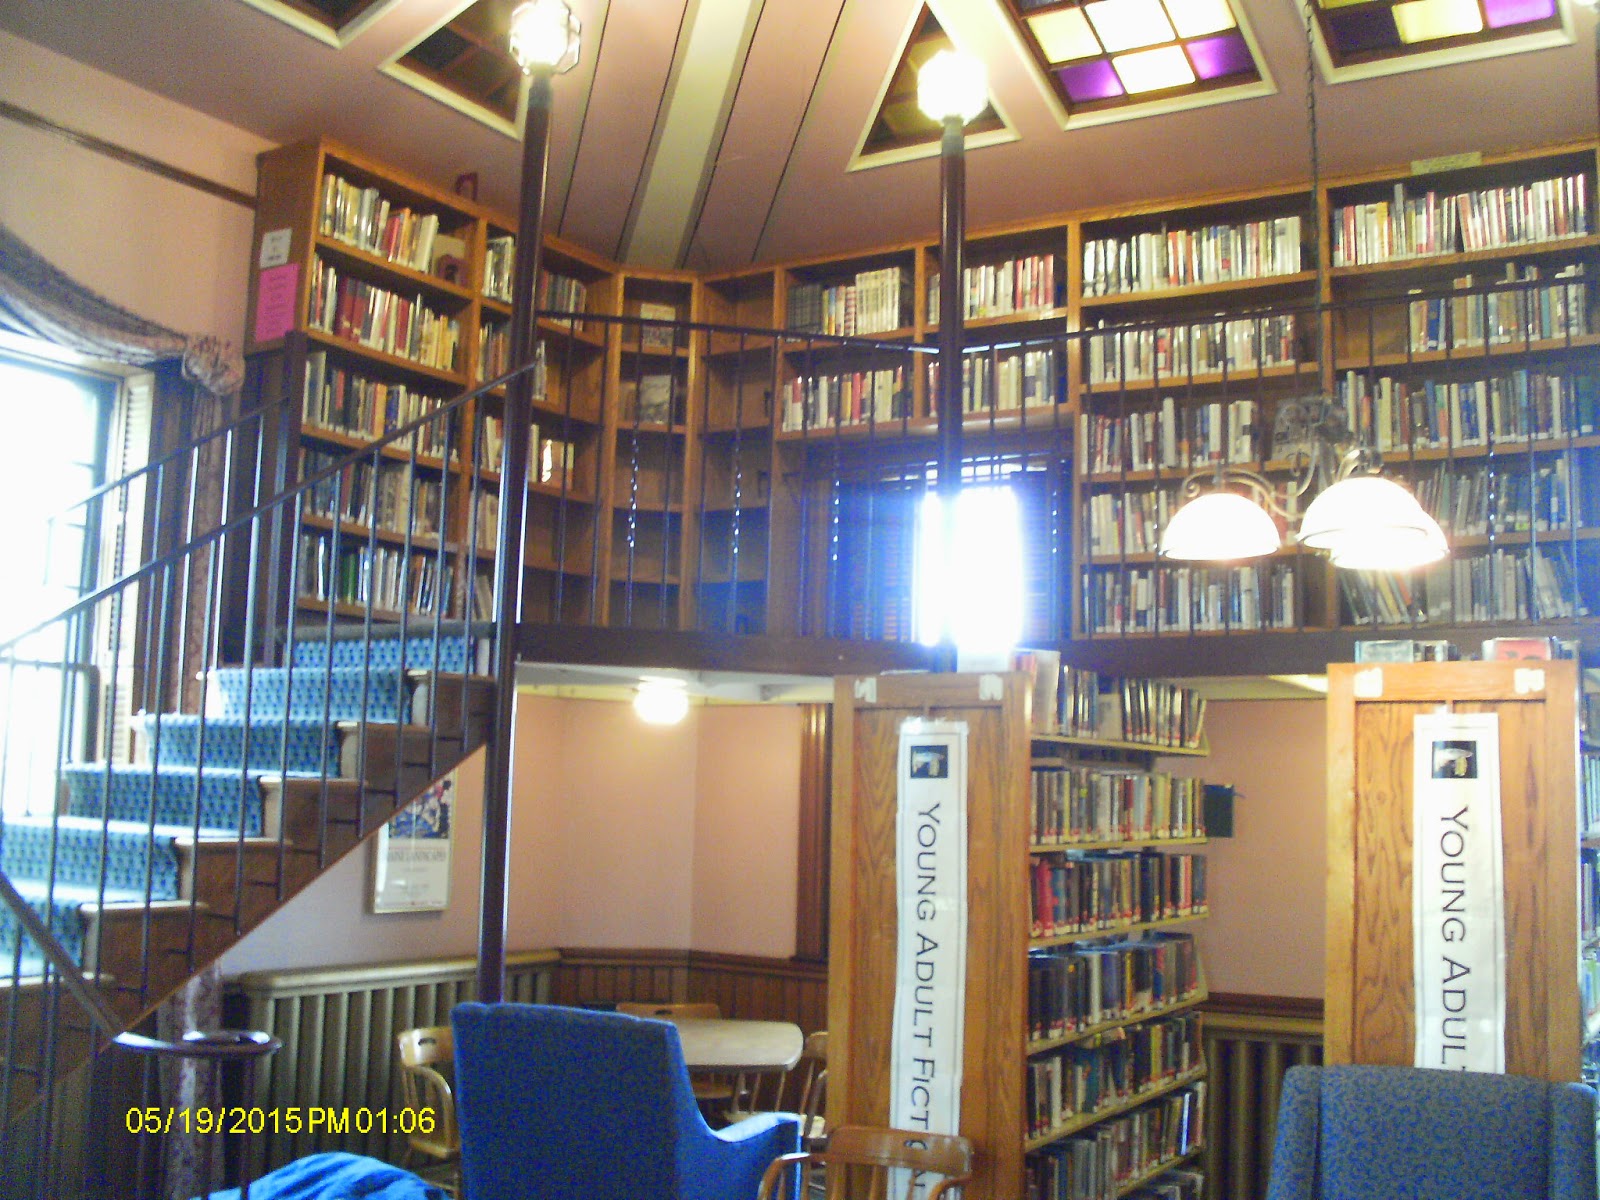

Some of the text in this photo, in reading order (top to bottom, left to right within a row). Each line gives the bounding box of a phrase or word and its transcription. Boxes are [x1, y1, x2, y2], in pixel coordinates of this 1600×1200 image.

[908, 803, 940, 1188] YOUNG ADULT FICT
[1440, 806, 1471, 1070] YOUNG ADUL
